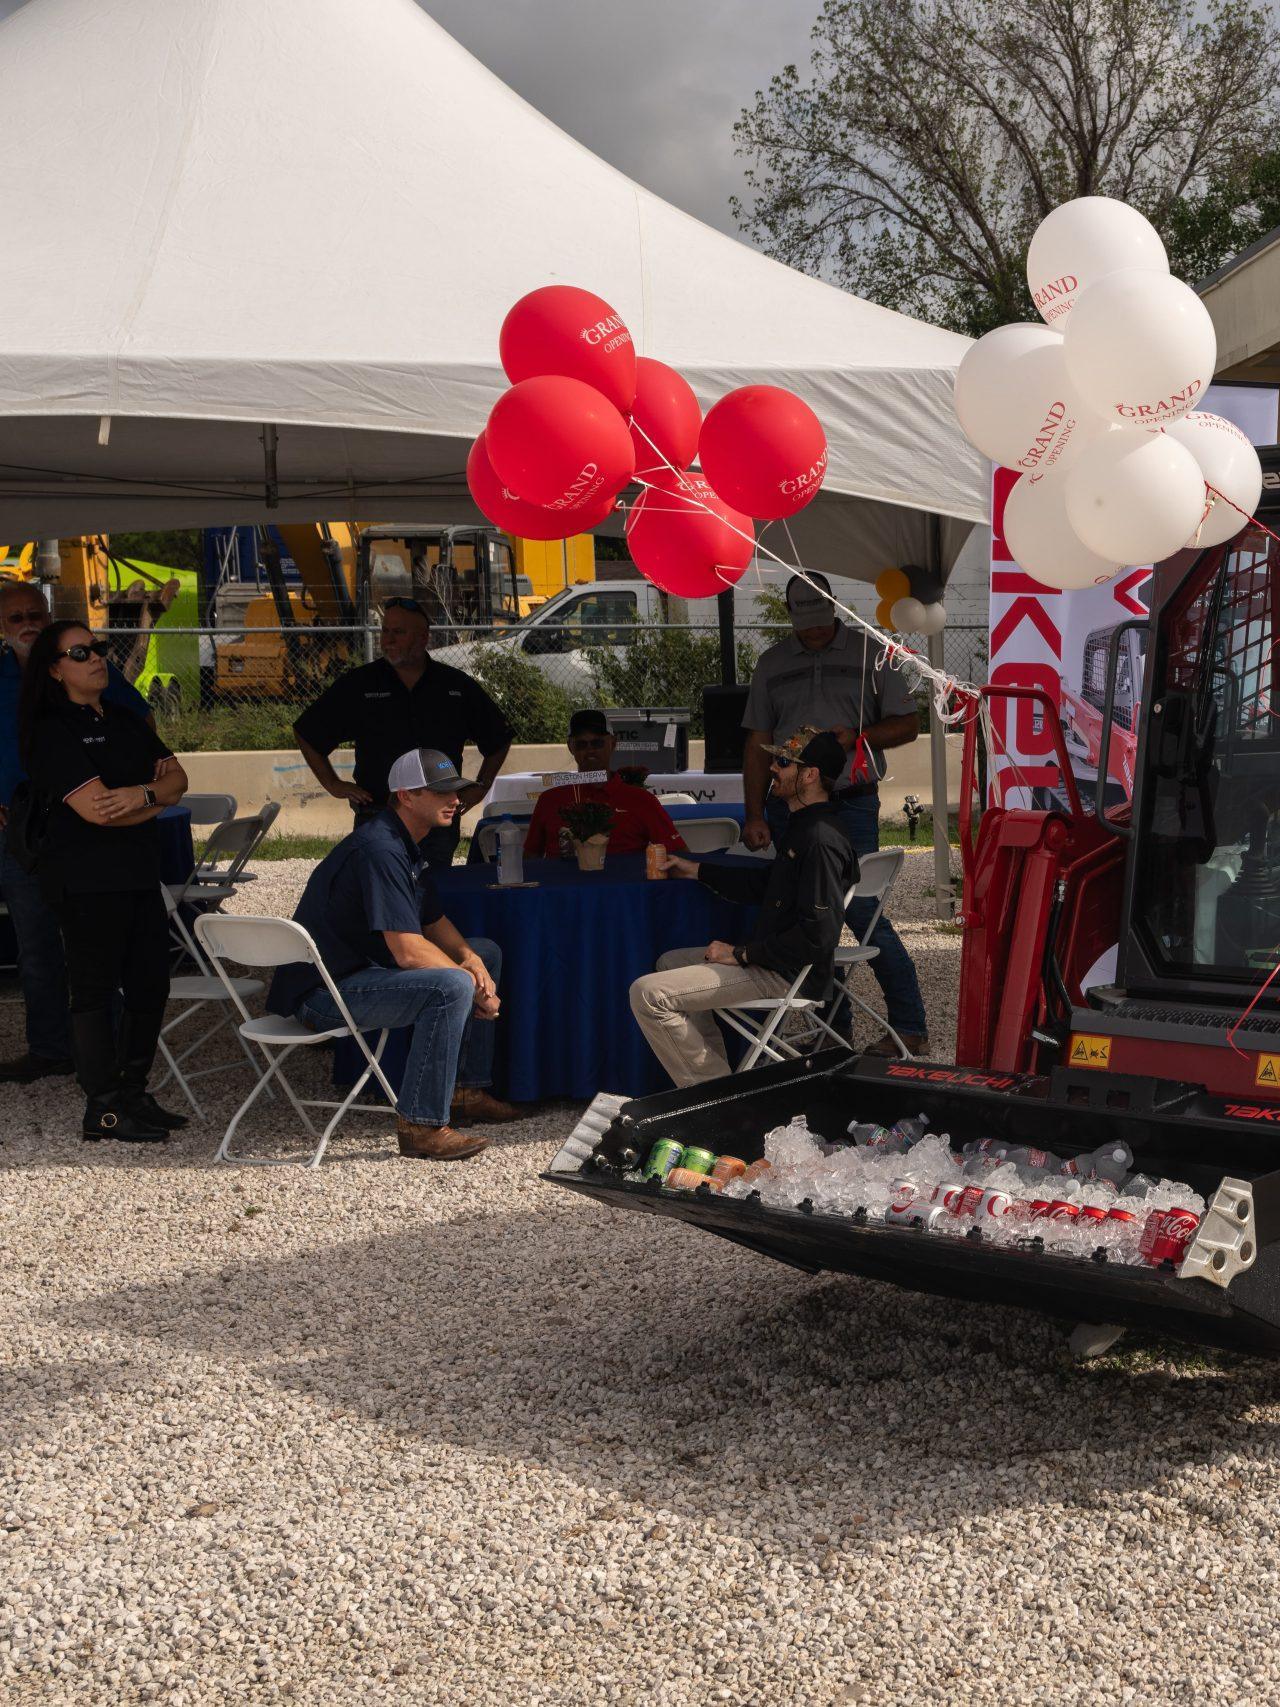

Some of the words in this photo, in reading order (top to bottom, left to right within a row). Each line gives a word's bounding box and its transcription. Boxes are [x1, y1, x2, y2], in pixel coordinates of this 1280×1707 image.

[1034, 275, 1078, 310] RAND
[585, 314, 625, 345] GRAN
[1117, 379, 1201, 418] GRAND
[1021, 402, 1066, 468] GRAND
[1045, 419, 1076, 466] OPENING
